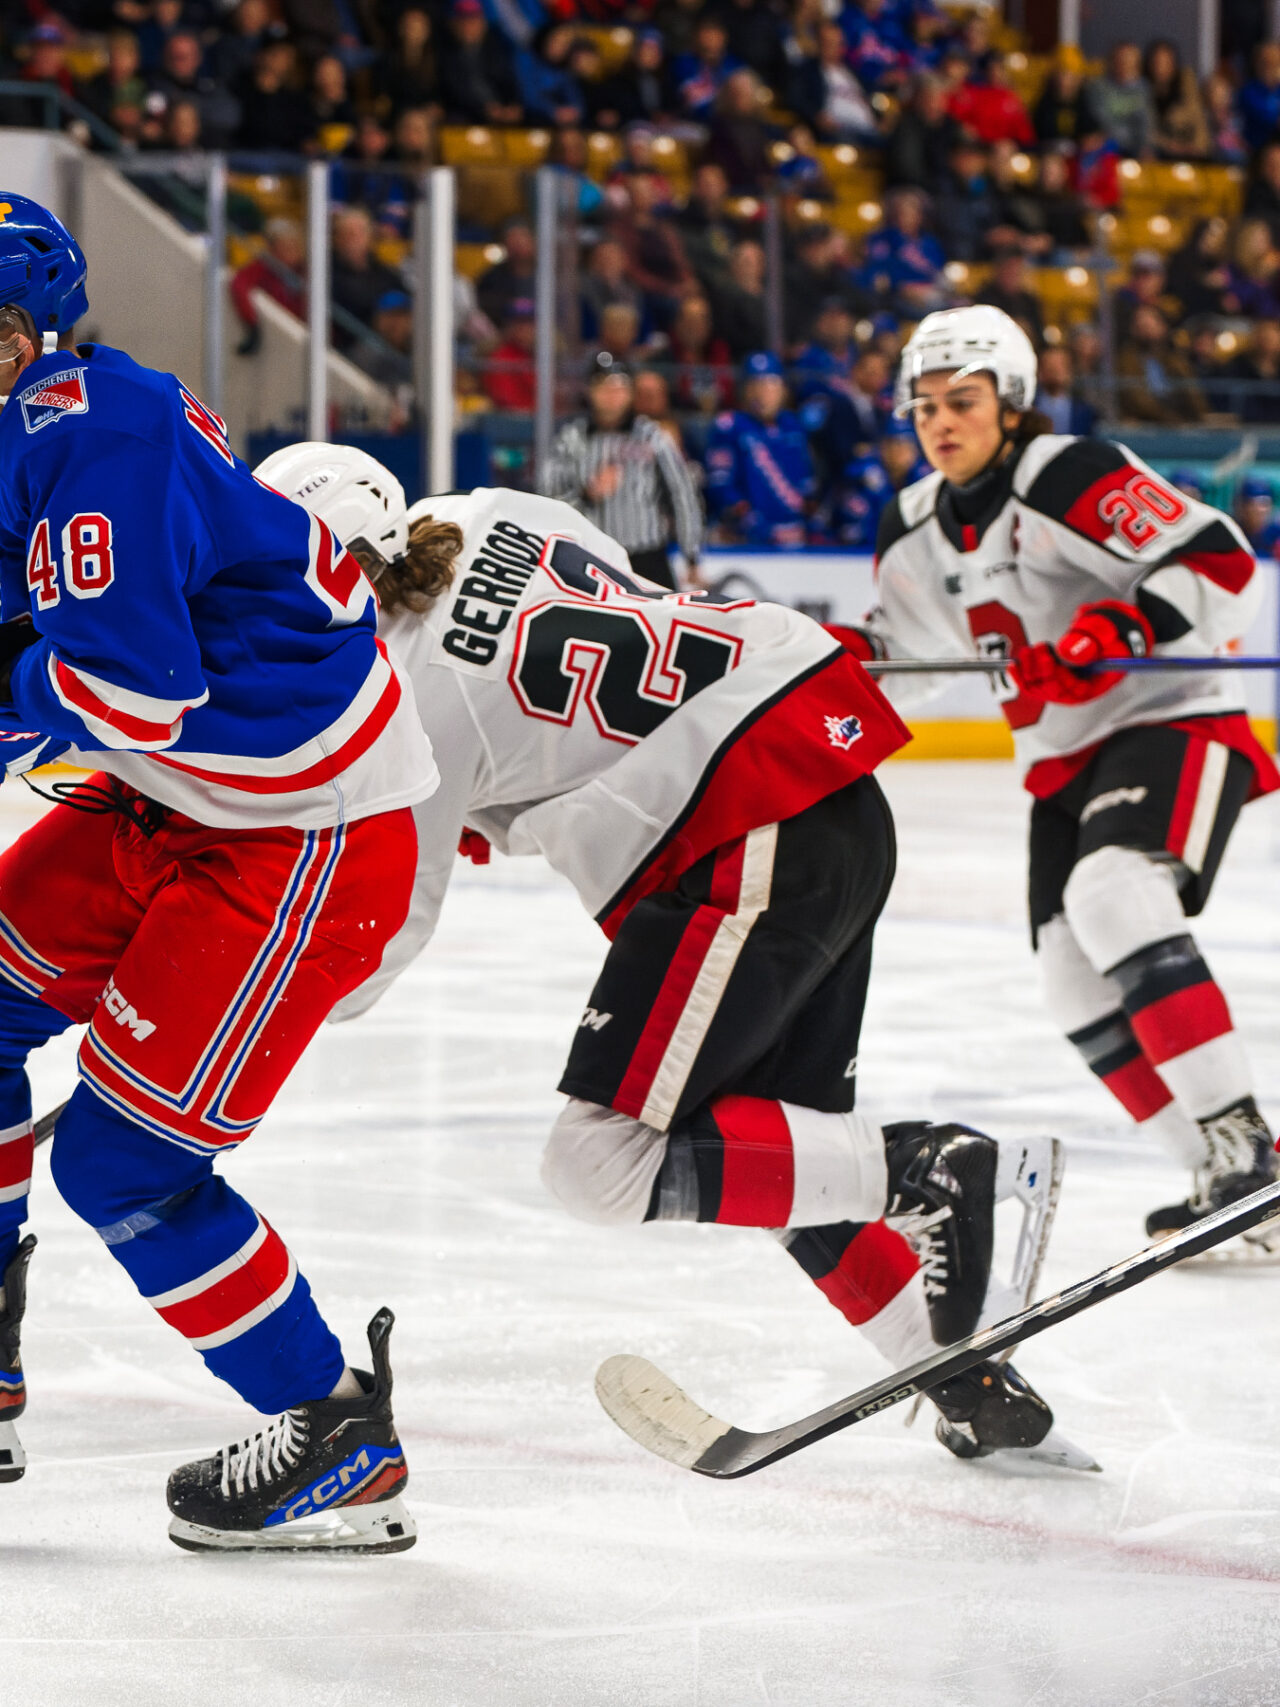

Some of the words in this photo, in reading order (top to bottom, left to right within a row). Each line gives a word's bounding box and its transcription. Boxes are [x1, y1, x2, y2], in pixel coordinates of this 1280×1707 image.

[24, 370, 79, 400] KITCHENER
[33, 392, 77, 410] RANGERS
[1097, 474, 1188, 553] 20
[27, 512, 115, 612] 48
[442, 520, 547, 666] GERRIOR
[507, 533, 757, 747] 22
[285, 1449, 371, 1521] CCM
